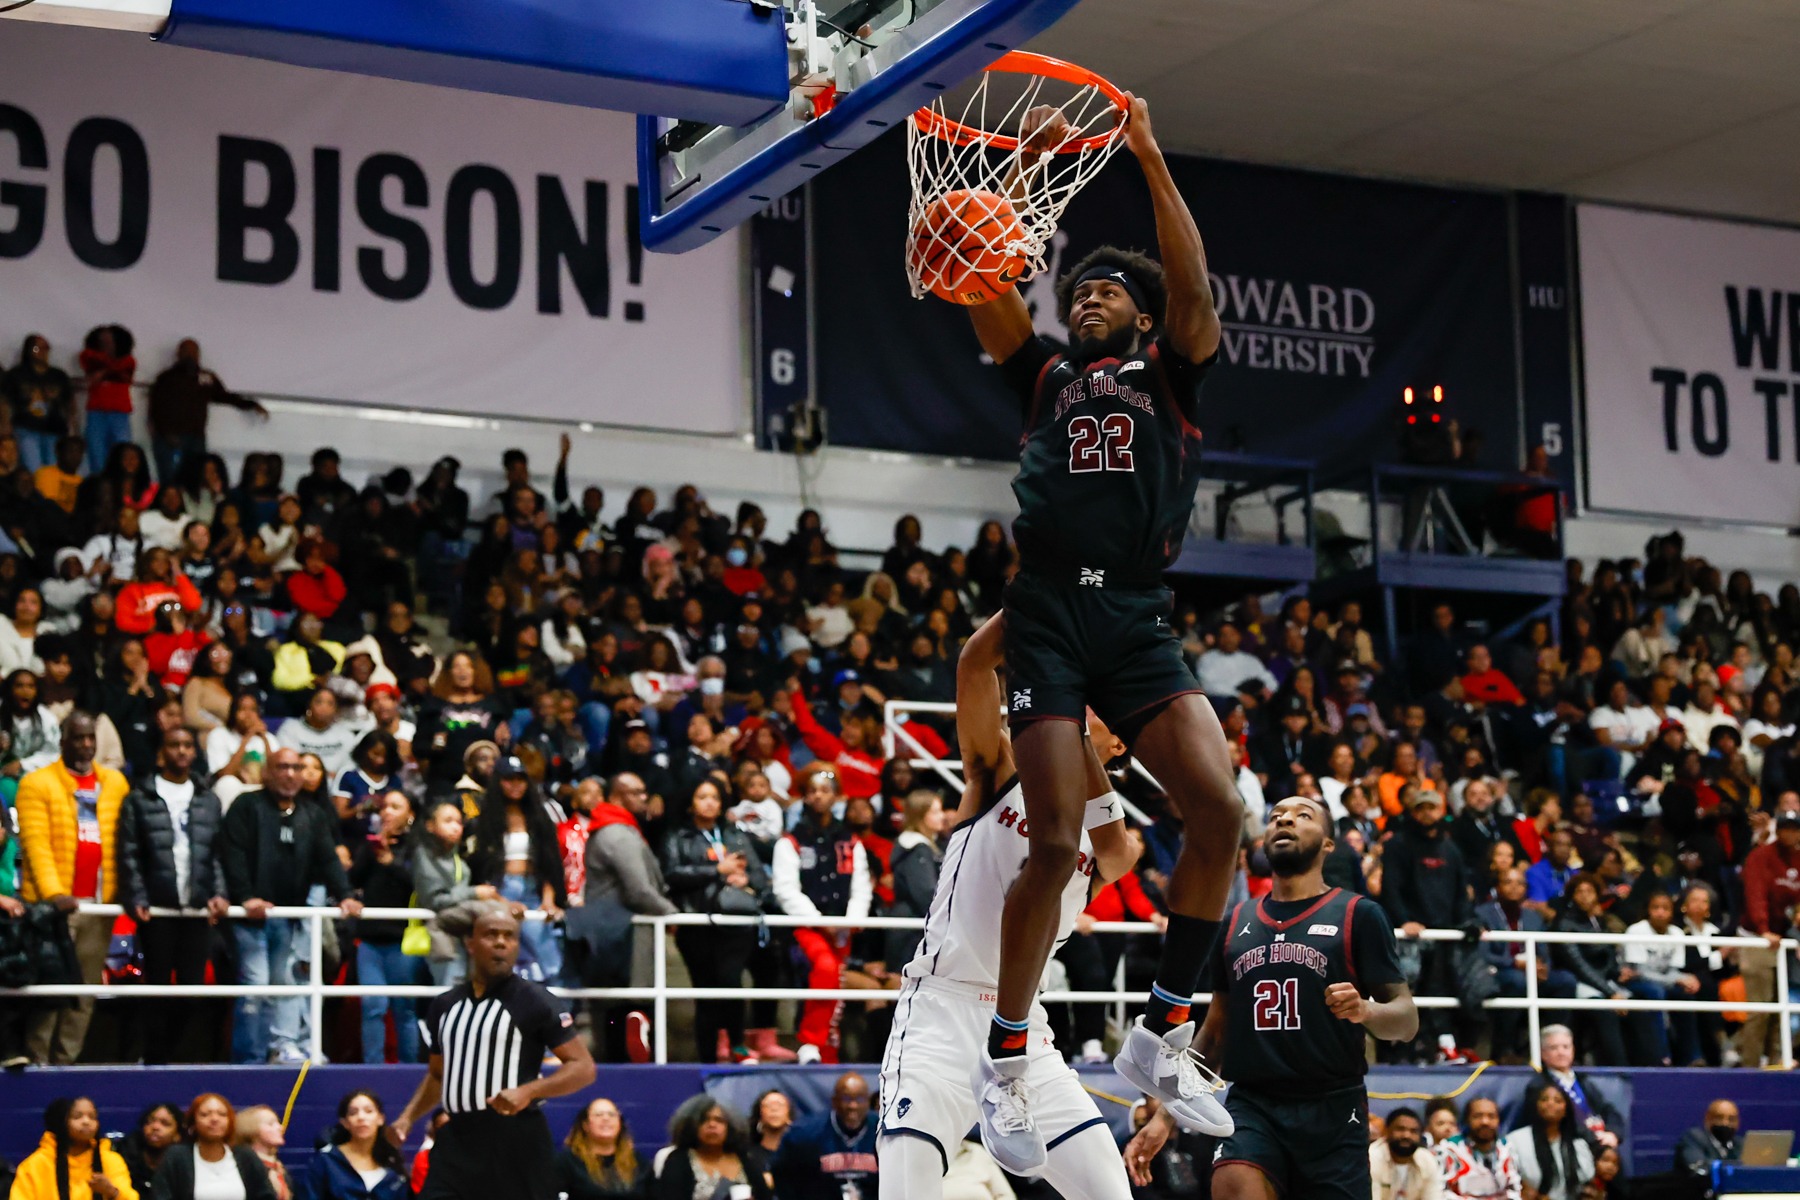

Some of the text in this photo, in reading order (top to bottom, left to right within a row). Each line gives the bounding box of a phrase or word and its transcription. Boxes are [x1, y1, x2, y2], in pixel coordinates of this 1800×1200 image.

[216, 133, 646, 323] BISON!
[1529, 285, 1564, 309] HU
[770, 347, 795, 386] 6
[1221, 329, 1376, 378] VERSITY
[1089, 374, 1155, 416] HOUSE
[1651, 366, 1730, 458] TO
[1068, 413, 1135, 474] 22
[1541, 421, 1562, 457] 5
[1233, 942, 1328, 980] THE HOUSE
[1253, 978, 1301, 1031] 21
